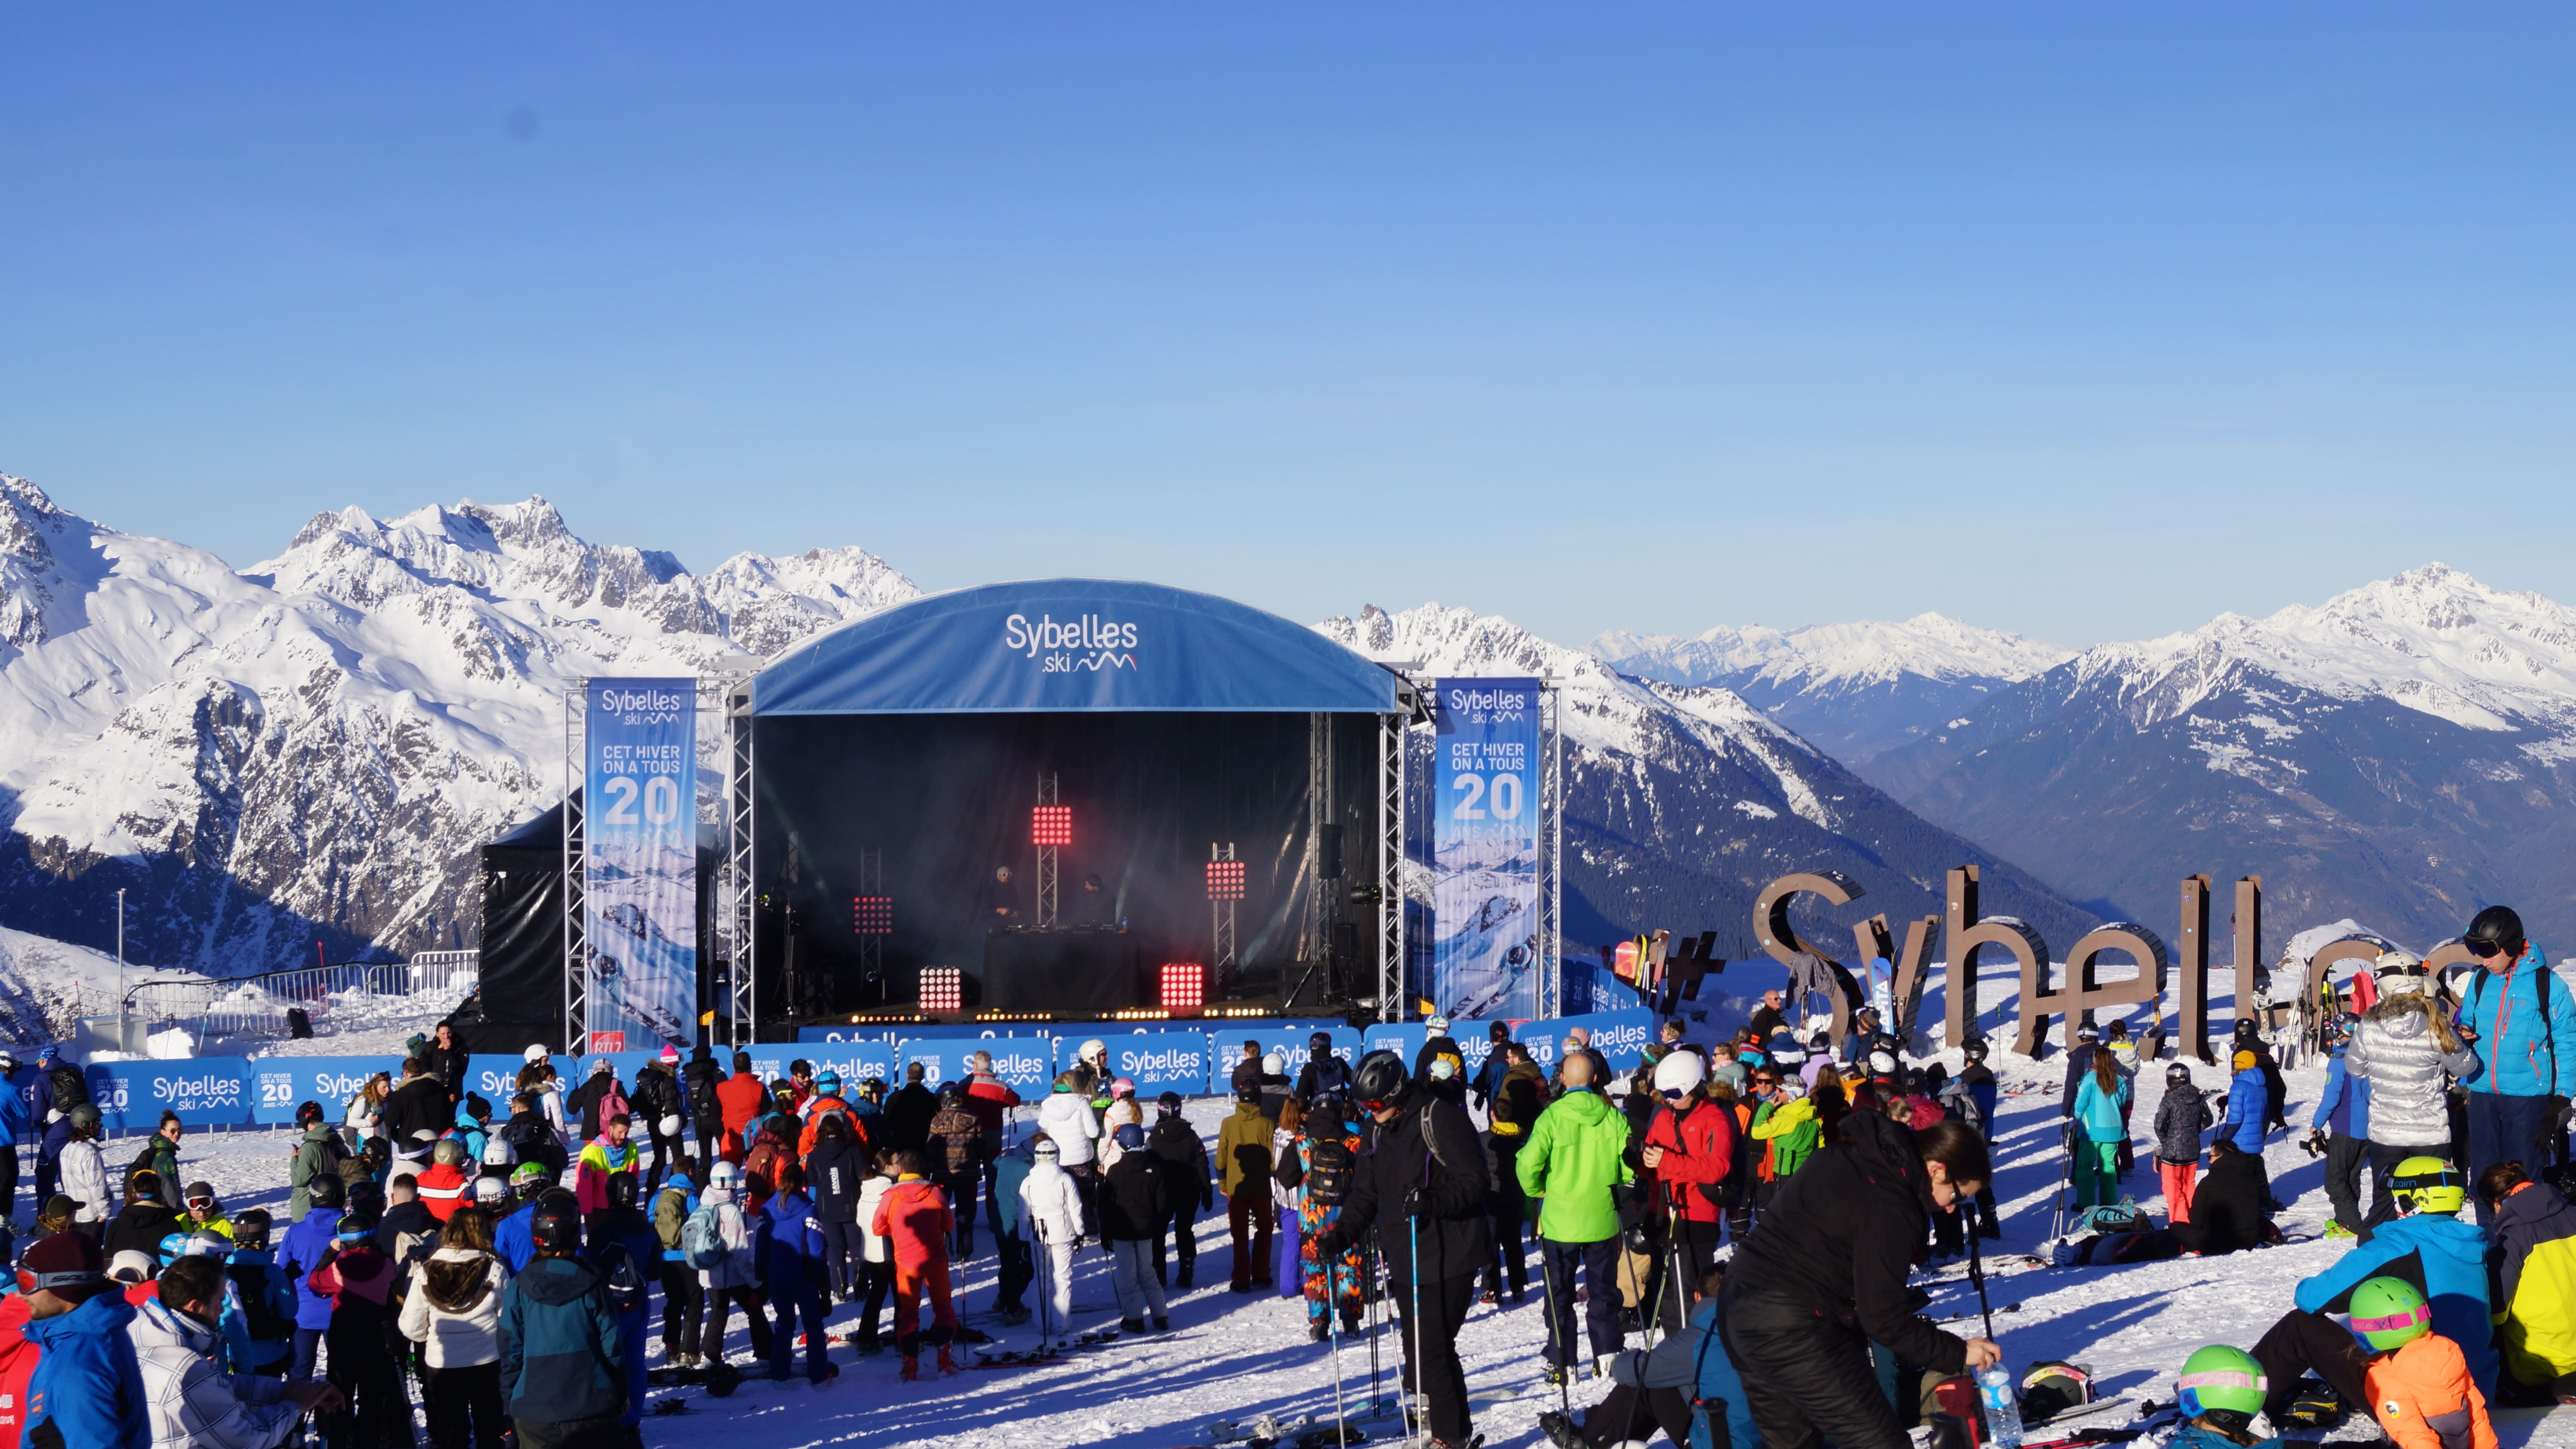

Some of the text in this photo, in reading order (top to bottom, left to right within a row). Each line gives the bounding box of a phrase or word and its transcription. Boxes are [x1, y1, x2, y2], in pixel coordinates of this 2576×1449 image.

[1006, 614, 1137, 658] Sybelles
[602, 689, 680, 716] Sybelles
[1452, 689, 1524, 715] Sybelles
[603, 746, 680, 759] CET HIVER
[1452, 743, 1524, 756] CET HIVER
[603, 761, 680, 773] ON A TOUS
[1452, 758, 1524, 771] ON A TOUS
[604, 776, 678, 825] 20
[1453, 773, 1522, 820] 20
[604, 831, 634, 843] ANS
[1452, 827, 1481, 838] ANS
[1122, 1049, 1200, 1076] Sybelles
[97, 1089, 128, 1108] 20
[153, 1075, 240, 1103] Sybelles
[261, 1084, 292, 1101] 20
